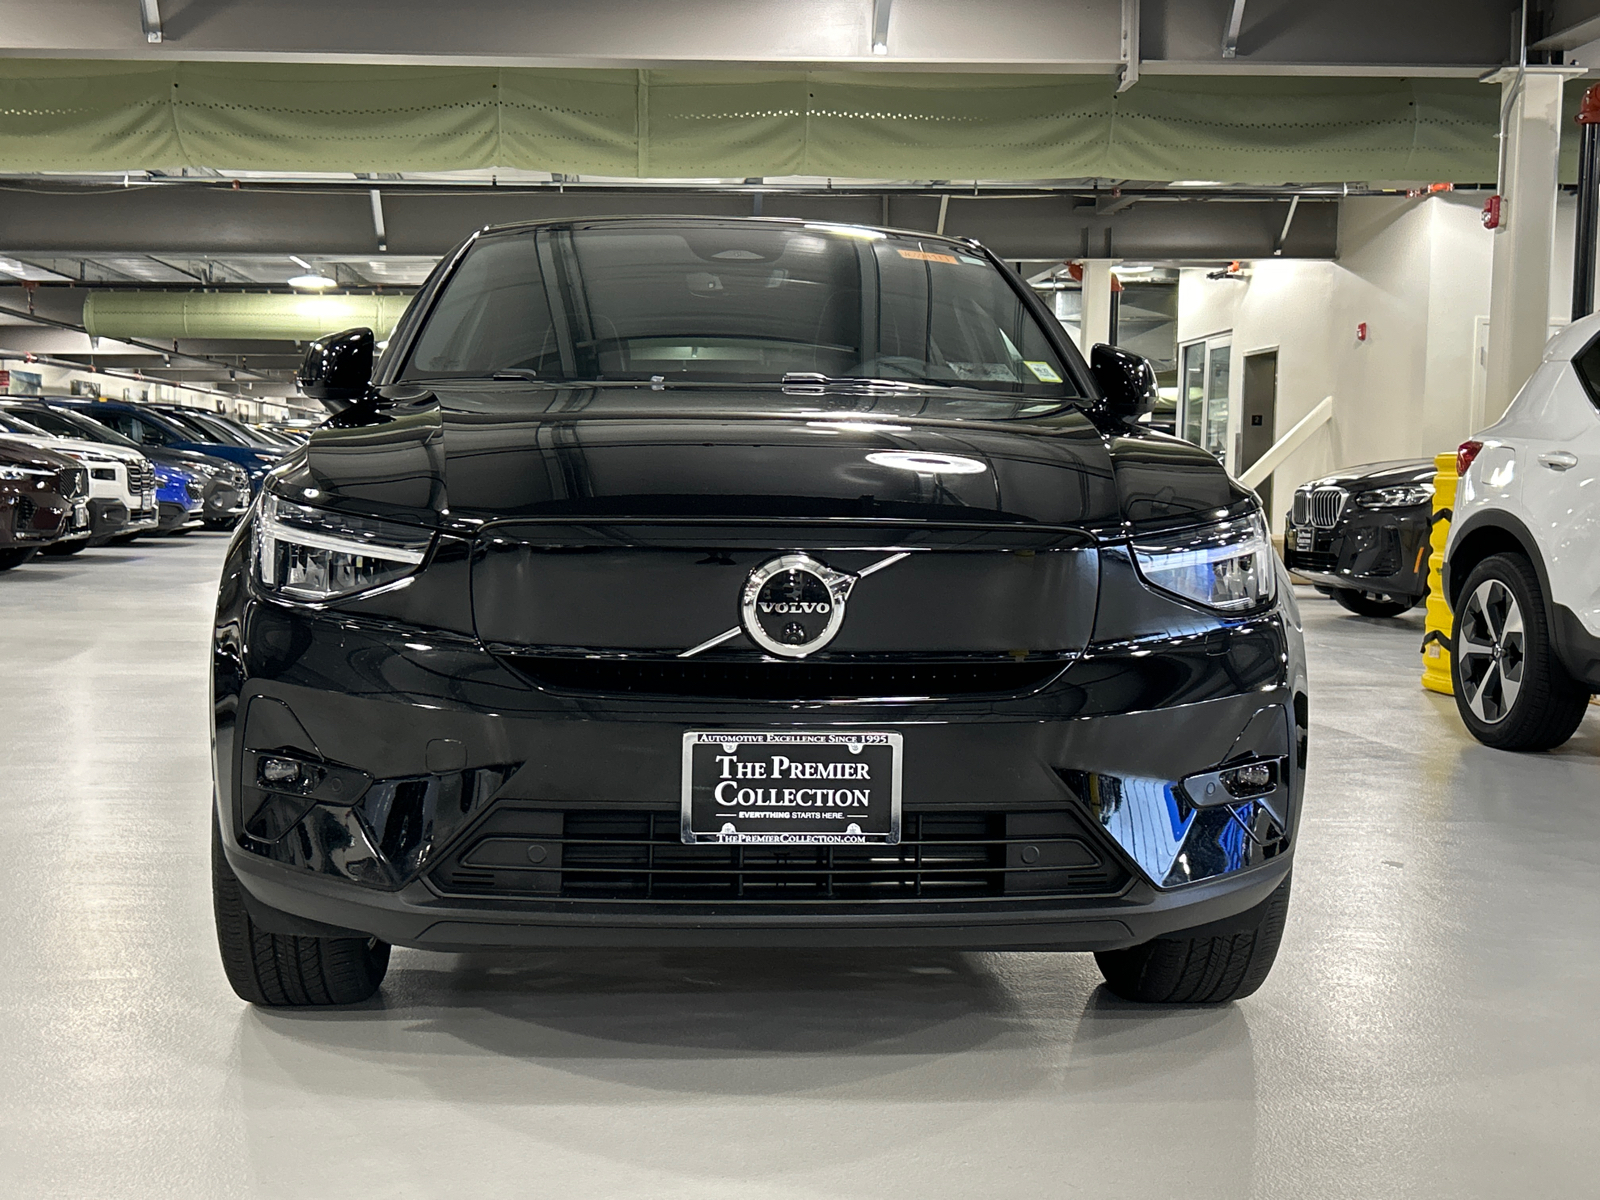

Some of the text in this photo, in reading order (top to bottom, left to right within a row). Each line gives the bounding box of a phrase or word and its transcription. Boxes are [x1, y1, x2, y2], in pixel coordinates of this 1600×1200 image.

[758, 602, 830, 614] VOLVO
[700, 733, 764, 743] AUTOMOTIVE
[828, 734, 857, 744] SINCE
[861, 735, 887, 744] 1995
[715, 755, 871, 780] THE PREMIER
[714, 781, 871, 808] COLLECTION
[739, 811, 791, 819] EVERYTHING
[822, 812, 845, 820] HERE.
